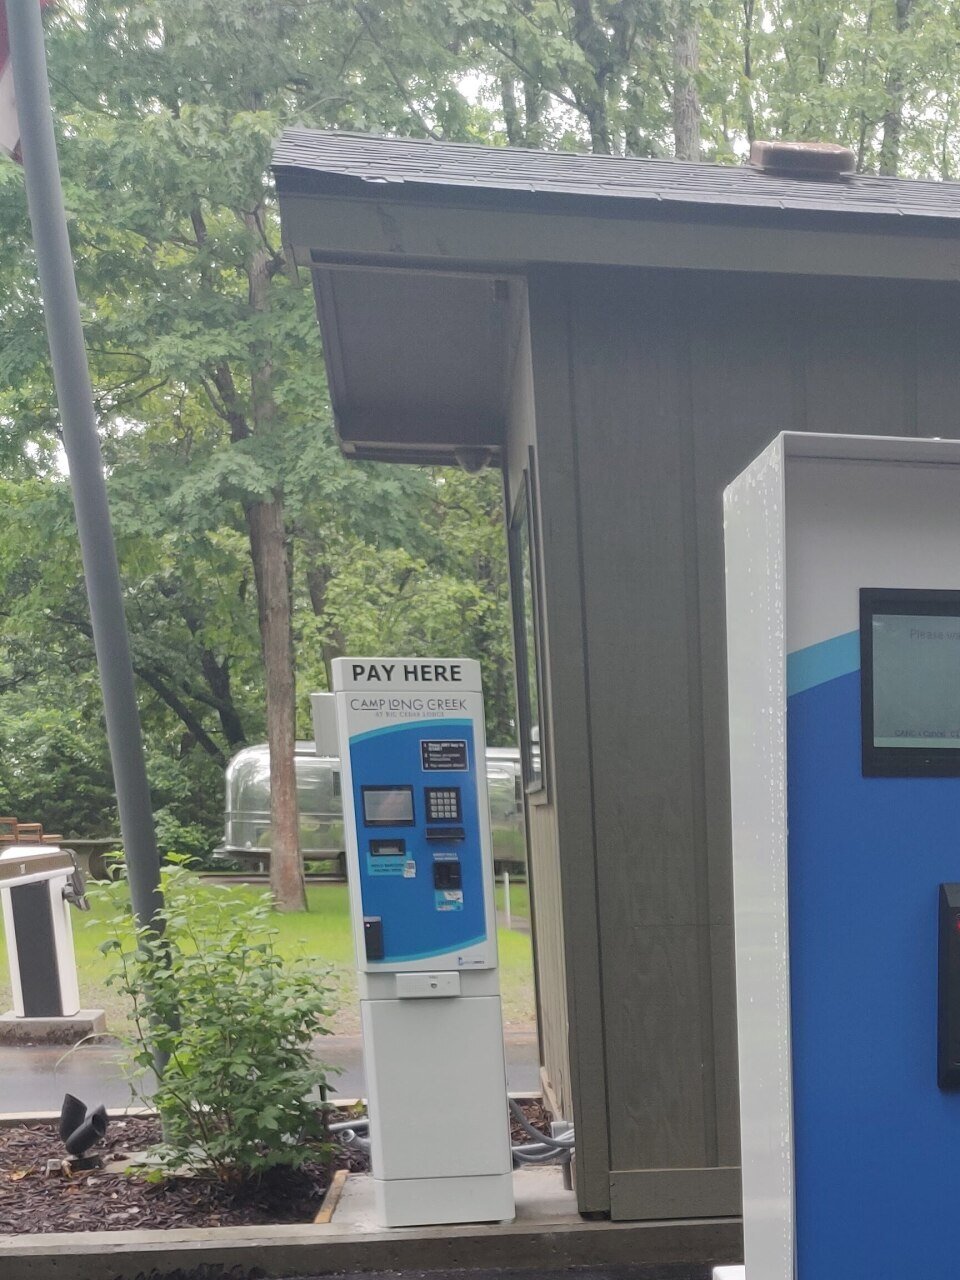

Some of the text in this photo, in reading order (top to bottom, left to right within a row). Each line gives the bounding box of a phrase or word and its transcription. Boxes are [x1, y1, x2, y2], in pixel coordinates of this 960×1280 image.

[910, 629, 945, 640] Please
[352, 664, 462, 681] PAY HERE
[350, 698, 468, 711] CAMP LONG CREEK
